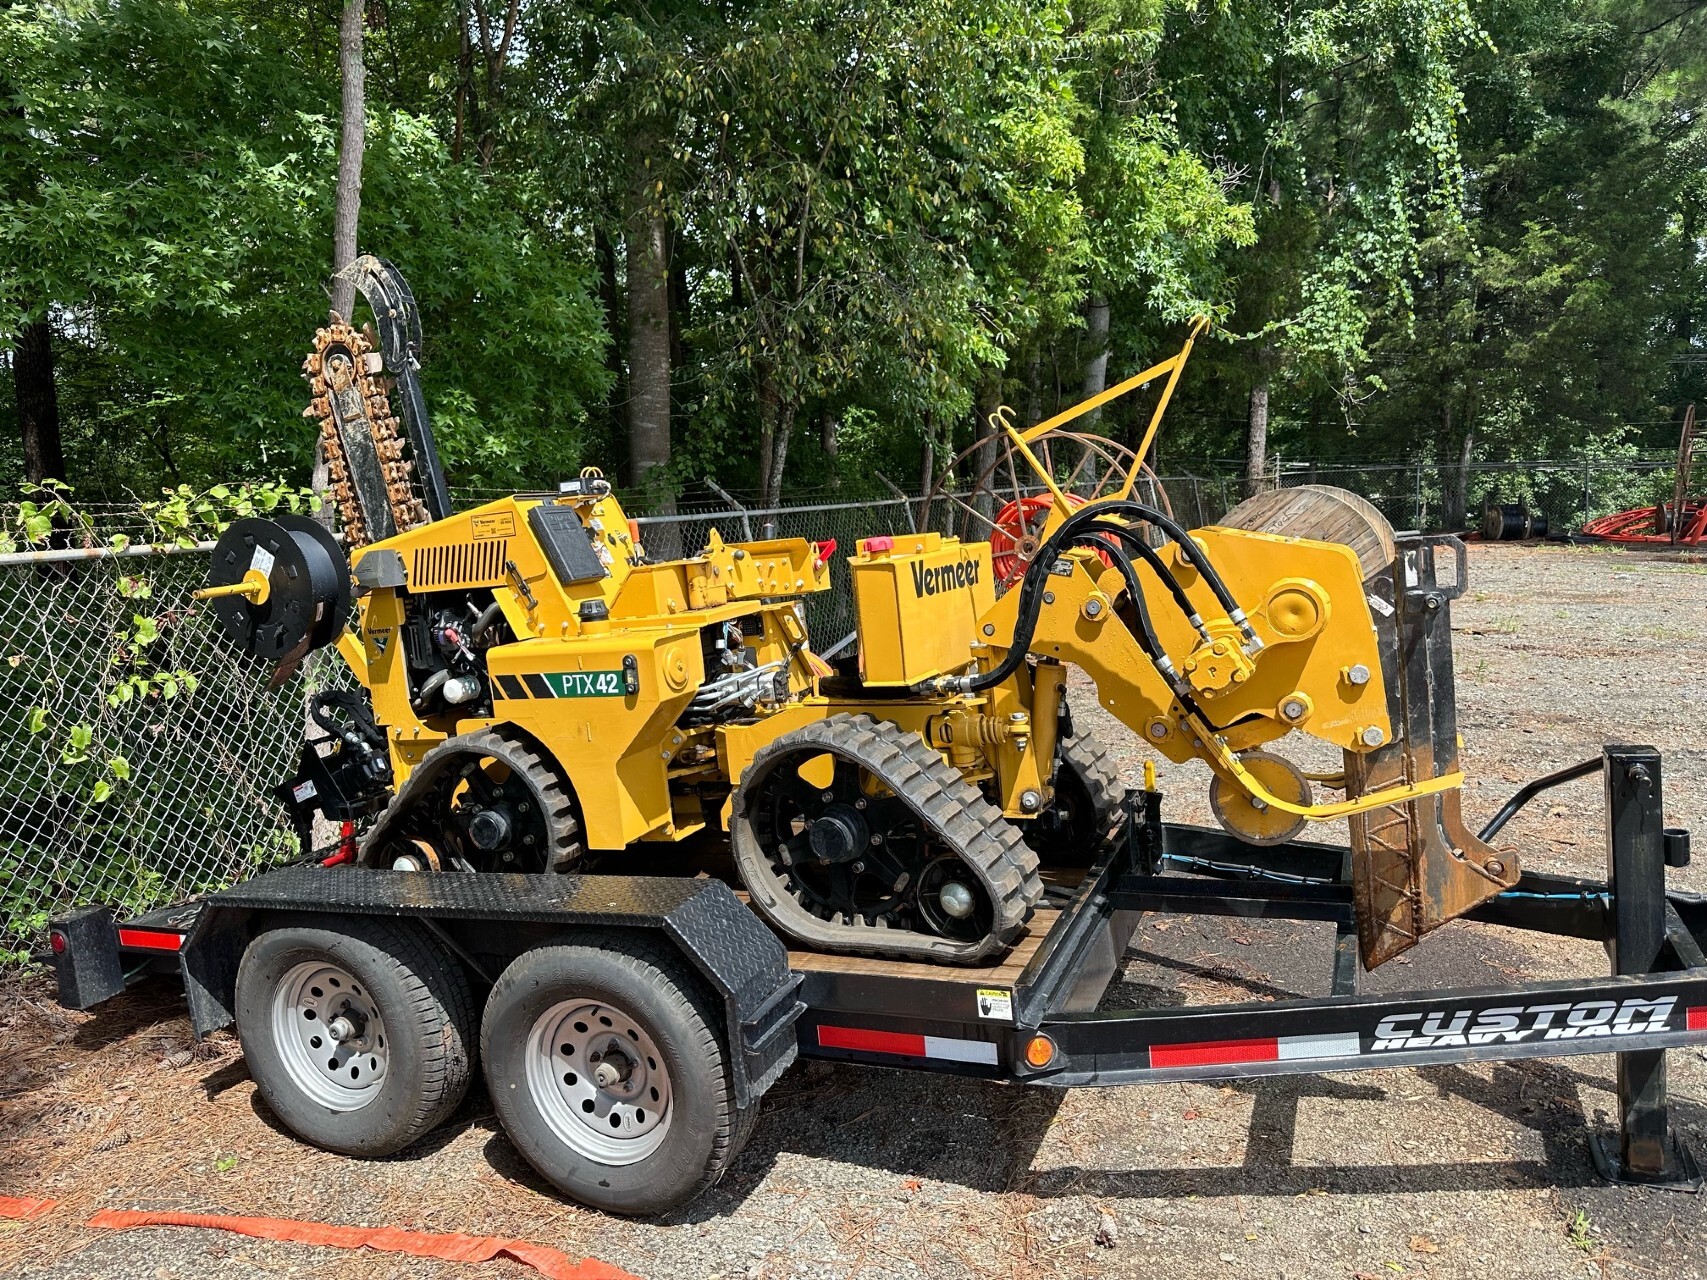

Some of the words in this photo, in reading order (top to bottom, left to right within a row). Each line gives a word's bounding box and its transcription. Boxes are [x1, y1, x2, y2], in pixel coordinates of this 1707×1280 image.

[910, 559, 980, 598] Vermeer
[562, 673, 619, 695] PTX42
[1374, 996, 1678, 1039] CUSTOM
[1371, 1029, 1535, 1050] HEAVY
[1544, 1021, 1671, 1040] HAUL
